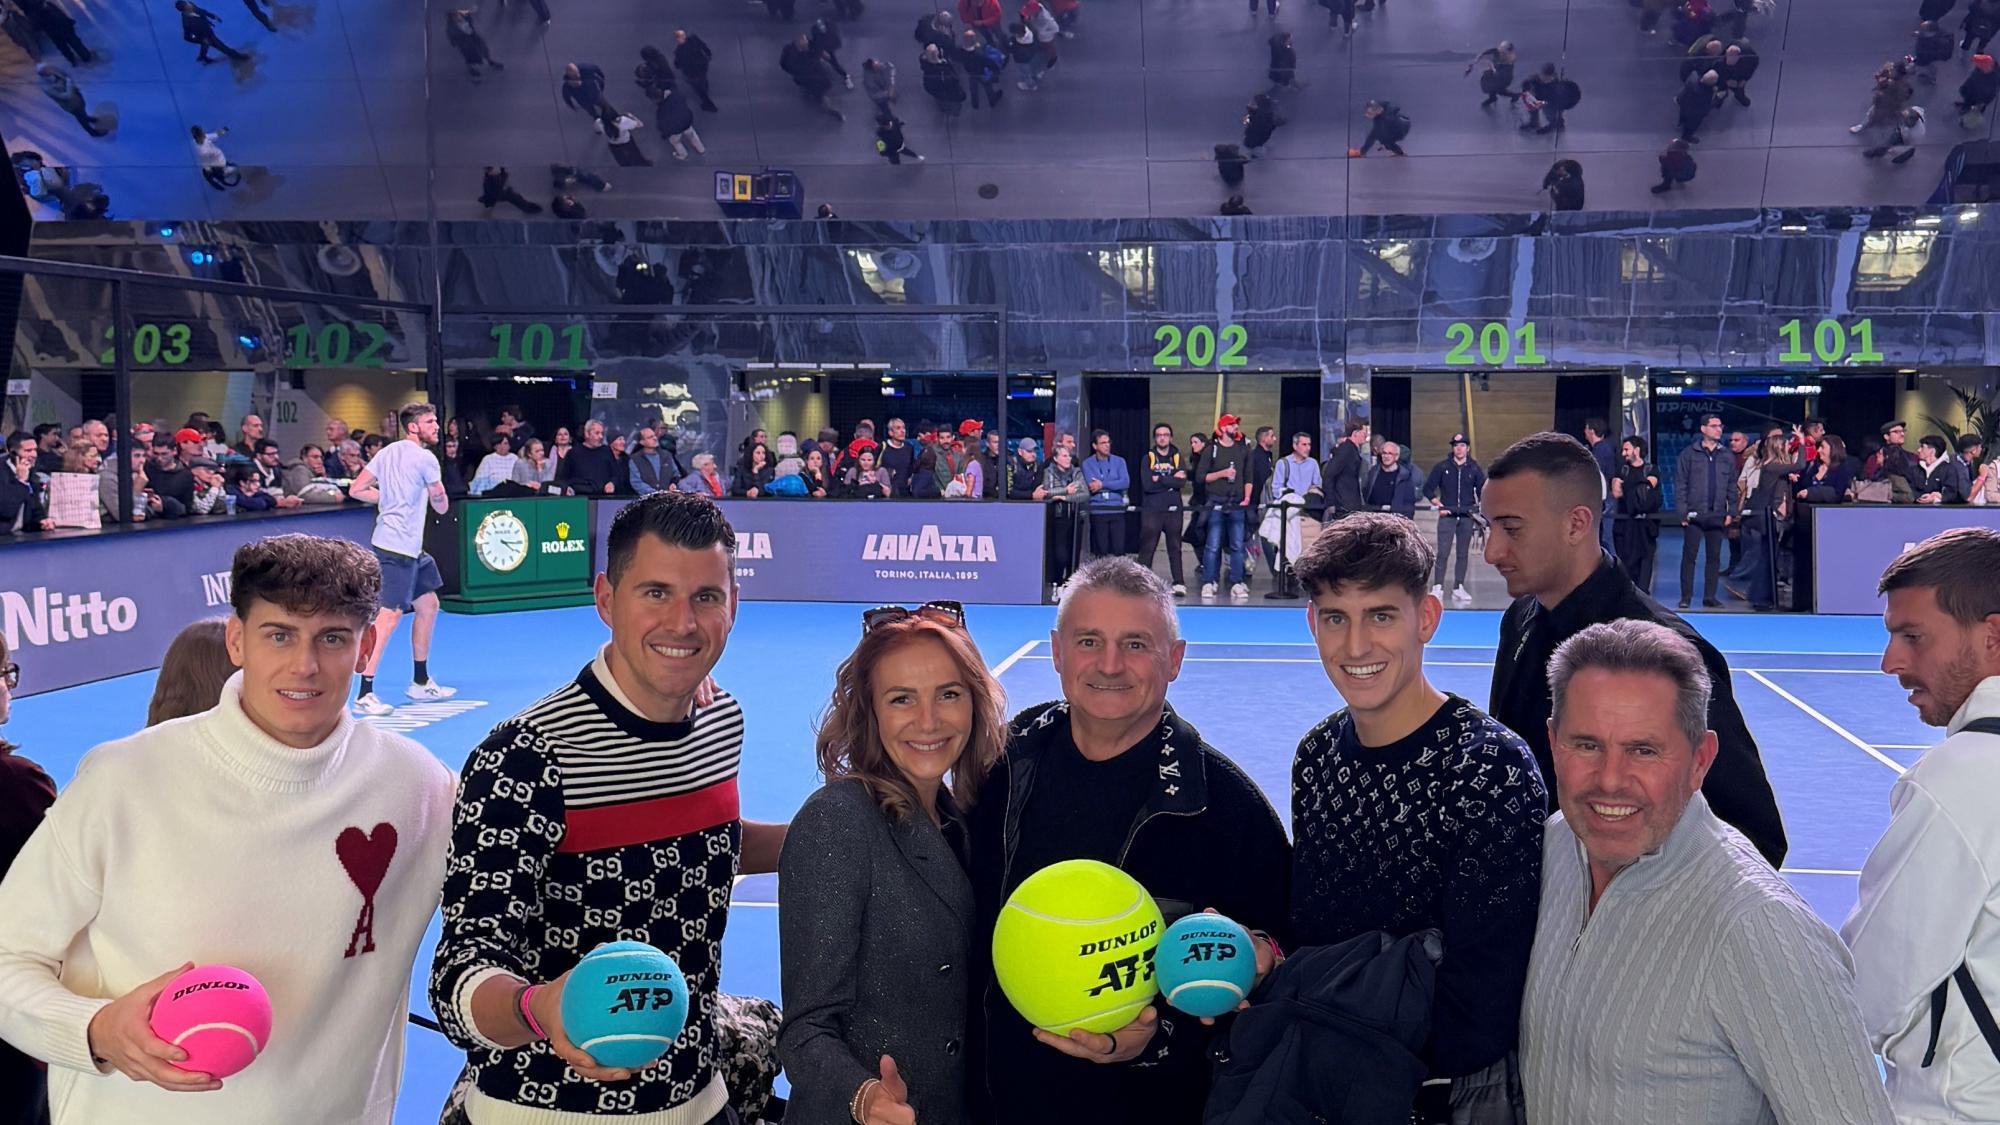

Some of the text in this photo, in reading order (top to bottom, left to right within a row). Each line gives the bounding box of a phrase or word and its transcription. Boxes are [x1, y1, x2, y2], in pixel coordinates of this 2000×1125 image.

[285, 323, 386, 368] 102
[488, 323, 589, 368] 101
[1153, 324, 1248, 366] 202
[1445, 322, 1546, 365] 201
[1779, 319, 1884, 363] 101
[276, 402, 298, 423] 102
[541, 540, 586, 554] ROLEX
[862, 525, 997, 561] LAVAZZA
[0, 587, 138, 651] Nitto
[1079, 920, 1157, 957] DUNLOP
[1179, 931, 1236, 941] DUNLOP
[1180, 943, 1237, 965] ATP
[172, 981, 250, 1002] DUNLOP
[605, 972, 672, 985] DUNLOP
[608, 987, 673, 1014] ATP
